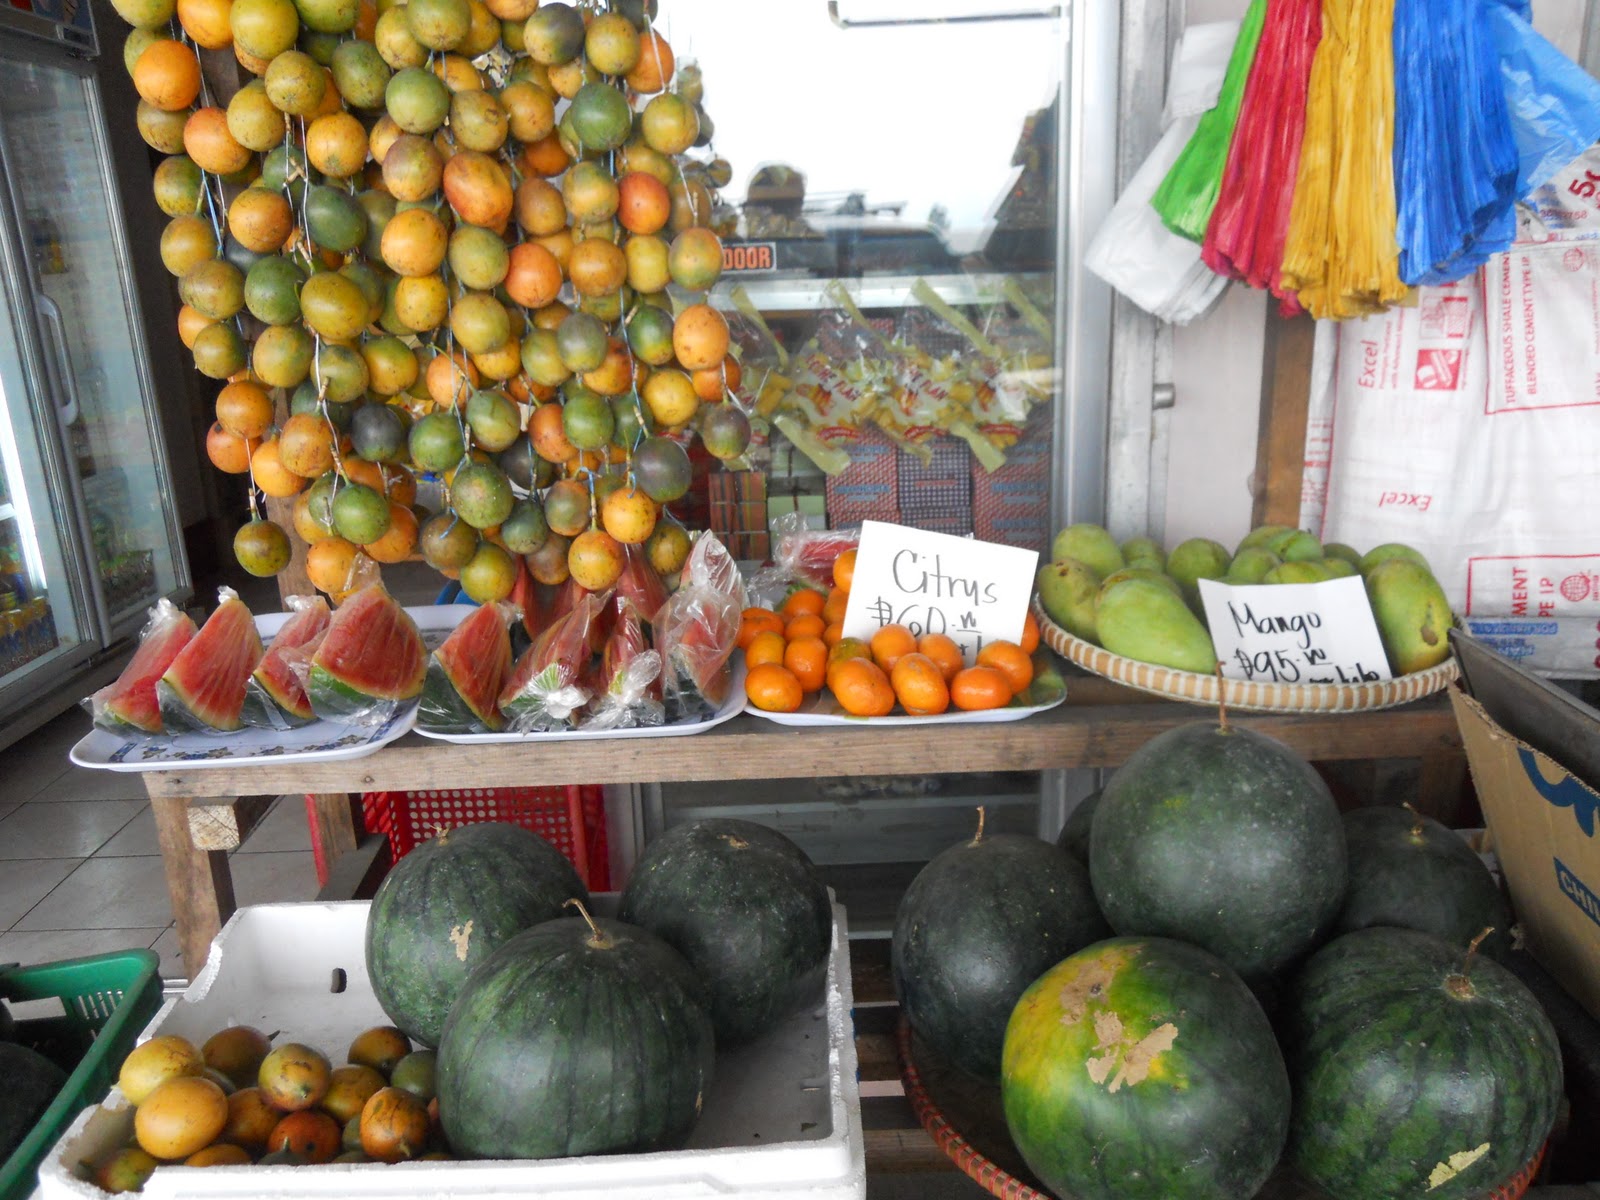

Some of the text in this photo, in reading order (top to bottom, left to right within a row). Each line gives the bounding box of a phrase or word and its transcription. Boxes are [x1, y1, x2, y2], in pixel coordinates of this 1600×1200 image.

[723, 246, 771, 270] DOOR
[1502, 251, 1511, 296] CEMENT
[1522, 269, 1532, 294] TYPE
[1502, 299, 1512, 333] SHALE
[1523, 299, 1534, 342] CEMENT
[1358, 339, 1378, 388] Excel
[1525, 345, 1537, 394] BLENDED
[1379, 492, 1432, 511] Excel
[1512, 567, 1528, 616] MENT
[1227, 601, 1322, 650] Mango
